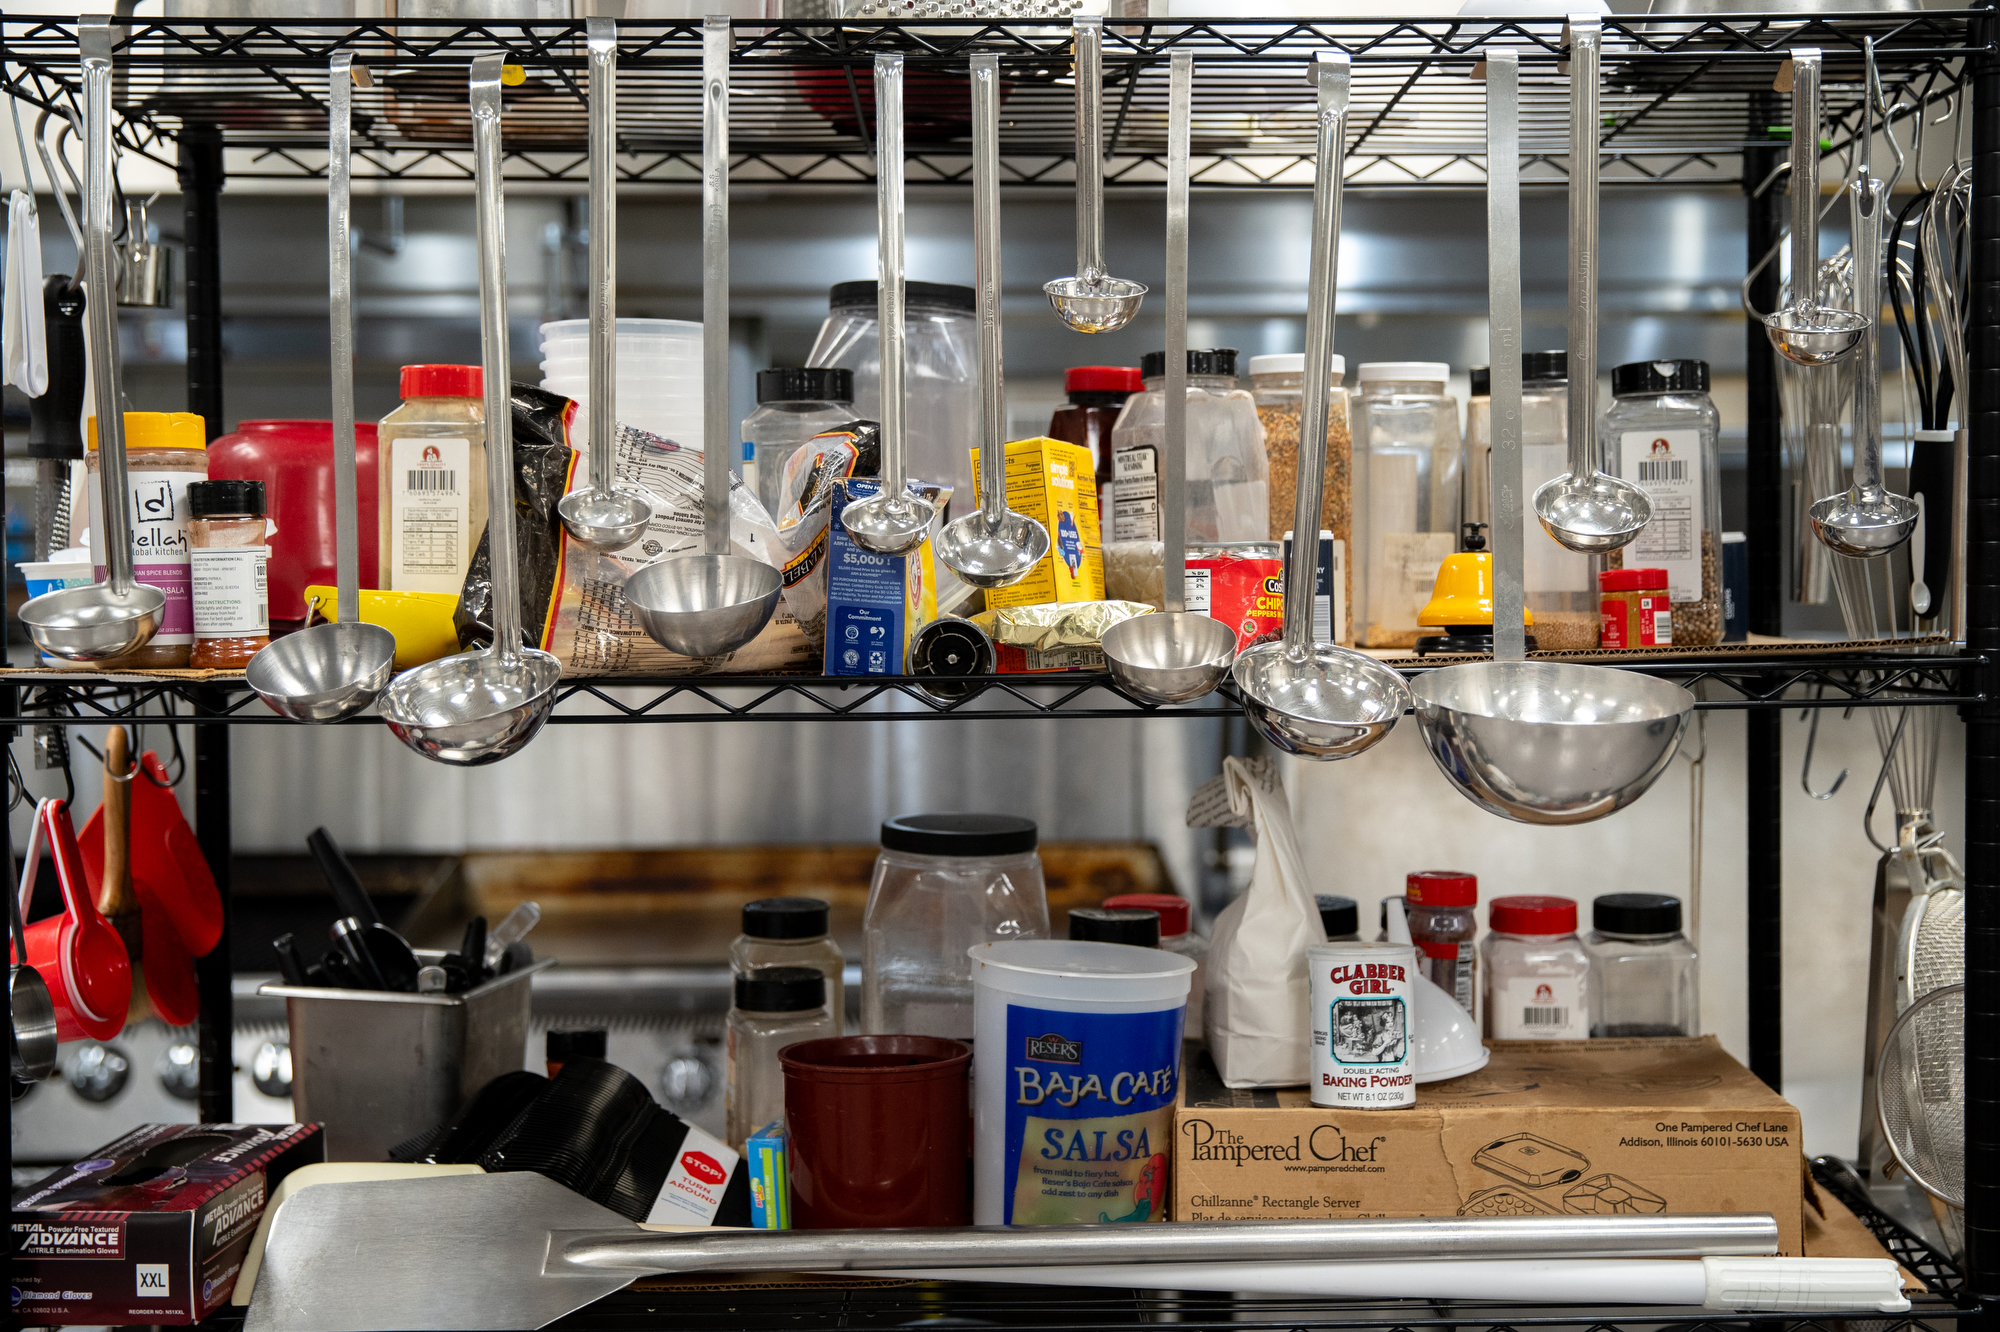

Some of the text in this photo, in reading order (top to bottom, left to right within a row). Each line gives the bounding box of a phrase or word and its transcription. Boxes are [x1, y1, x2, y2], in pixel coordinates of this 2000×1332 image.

[1502, 428, 1516, 450] 32
[1050, 461, 1068, 477] simple
[1051, 474, 1074, 490] solutions
[155, 548, 183, 556] kitchen
[843, 553, 884, 565] $5,000
[1246, 610, 1276, 618] PEPPERS
[1331, 964, 1406, 984] CLABBER
[1349, 980, 1392, 995] GIRL
[1030, 1040, 1078, 1060] RESER'S
[1014, 1066, 1108, 1108] BAJA
[1323, 1073, 1412, 1088] BAKING POWDER
[1656, 1122, 1788, 1134] One Pampered Chef Lane
[1040, 1127, 1152, 1162] SALSA
[1182, 1119, 1301, 1167] Pampered
[1215, 1130, 1244, 1144] The
[1619, 1137, 1788, 1148] Addison, Illinois 60101-5630 USA
[213, 1128, 274, 1163] ADVANCE
[685, 1156, 722, 1180] STOP!
[1033, 1166, 1053, 1175] from
[1054, 1167, 1072, 1176] mild
[1085, 1170, 1103, 1179] fiery
[1105, 1170, 1119, 1178] hot,
[1284, 1164, 1385, 1174] www.pamperedchef.com
[683, 1176, 711, 1194] TURN
[1042, 1177, 1133, 1189] Reser's Baja Cafe salsas
[669, 1180, 717, 1205] AROUND
[1088, 1191, 1102, 1199] any
[1104, 1189, 1119, 1197] dish
[202, 1182, 264, 1227] METAL Powder Free Textured
[1262, 1196, 1319, 1210] Rectangle
[1323, 1197, 1360, 1208] Server
[212, 1189, 264, 1245] ADVANCE
[20, 1233, 118, 1250] ADVANCE
[140, 1272, 166, 1288] XXL
[22, 1291, 93, 1300] Diamond Gloves
